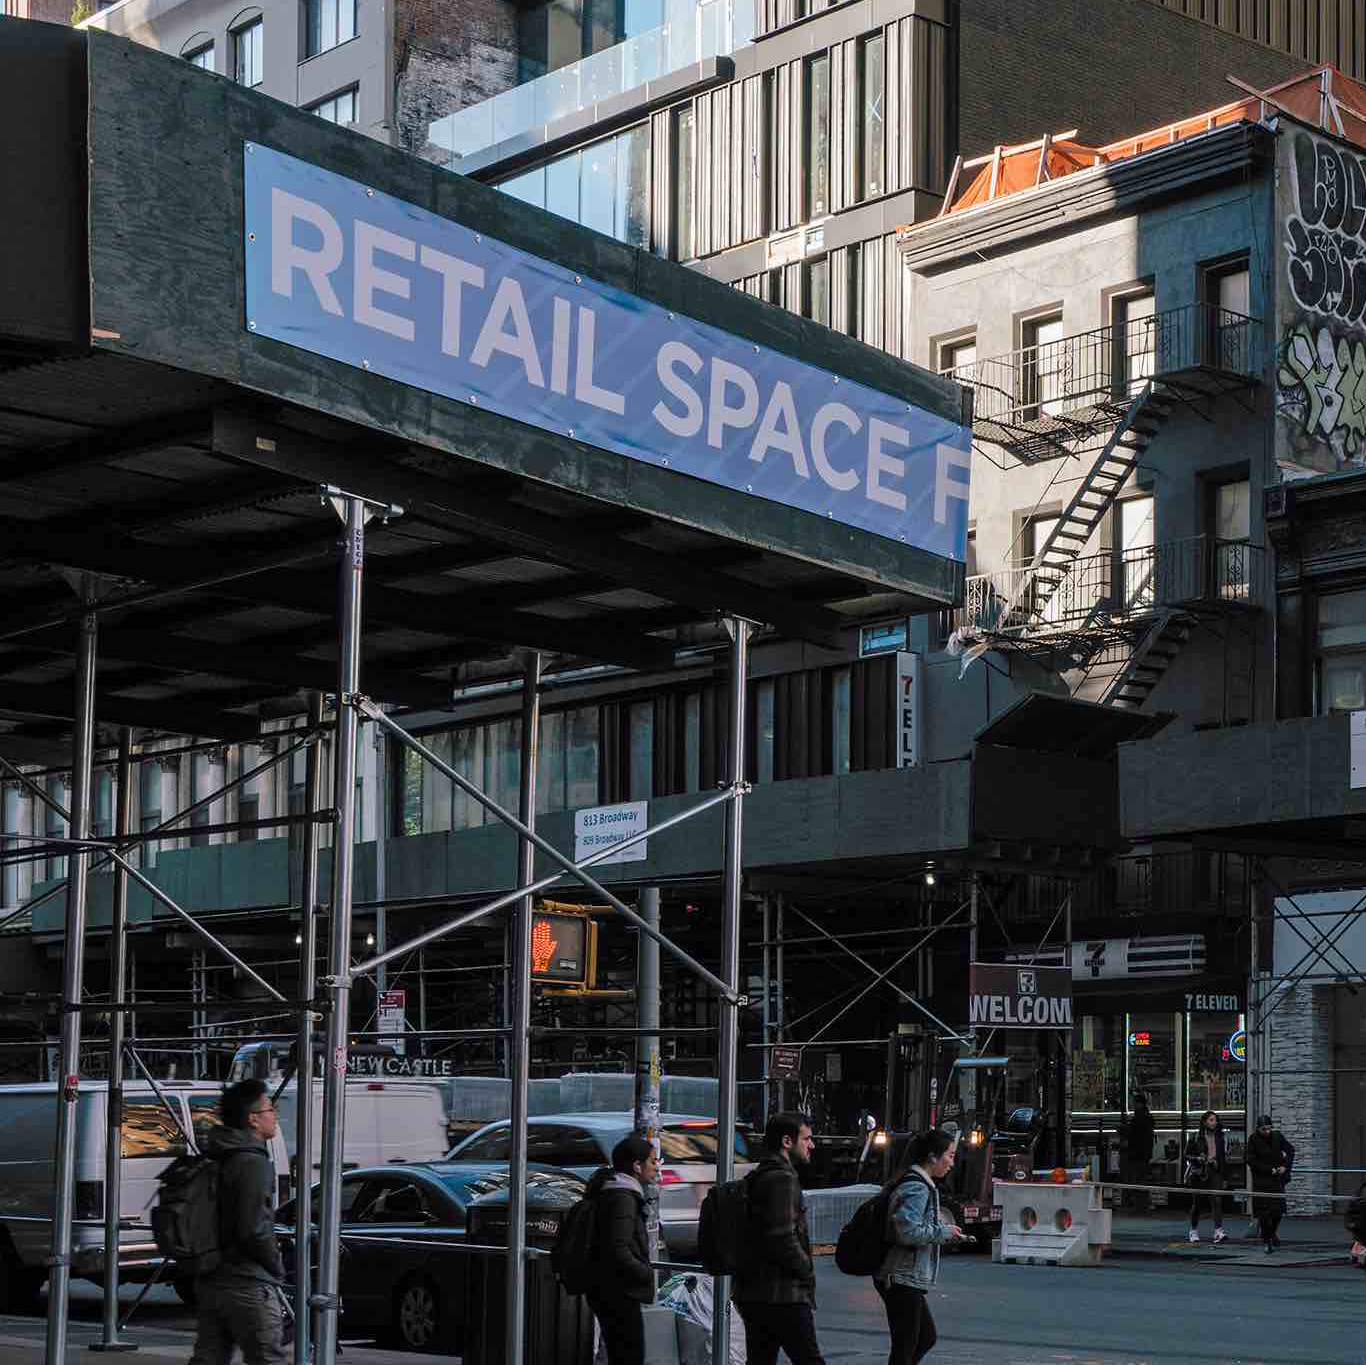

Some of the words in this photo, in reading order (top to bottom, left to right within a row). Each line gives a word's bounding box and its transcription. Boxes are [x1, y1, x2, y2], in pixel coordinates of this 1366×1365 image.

[271, 187, 625, 414] RETAIL
[652, 341, 912, 510] SPACE
[583, 813, 598, 827] 813
[599, 811, 640, 825] Broadway
[969, 995, 1072, 1024] WELCOM
[1185, 993, 1194, 1010] 7
[346, 1055, 384, 1074] NEW
[386, 1057, 453, 1075] CASTLE
